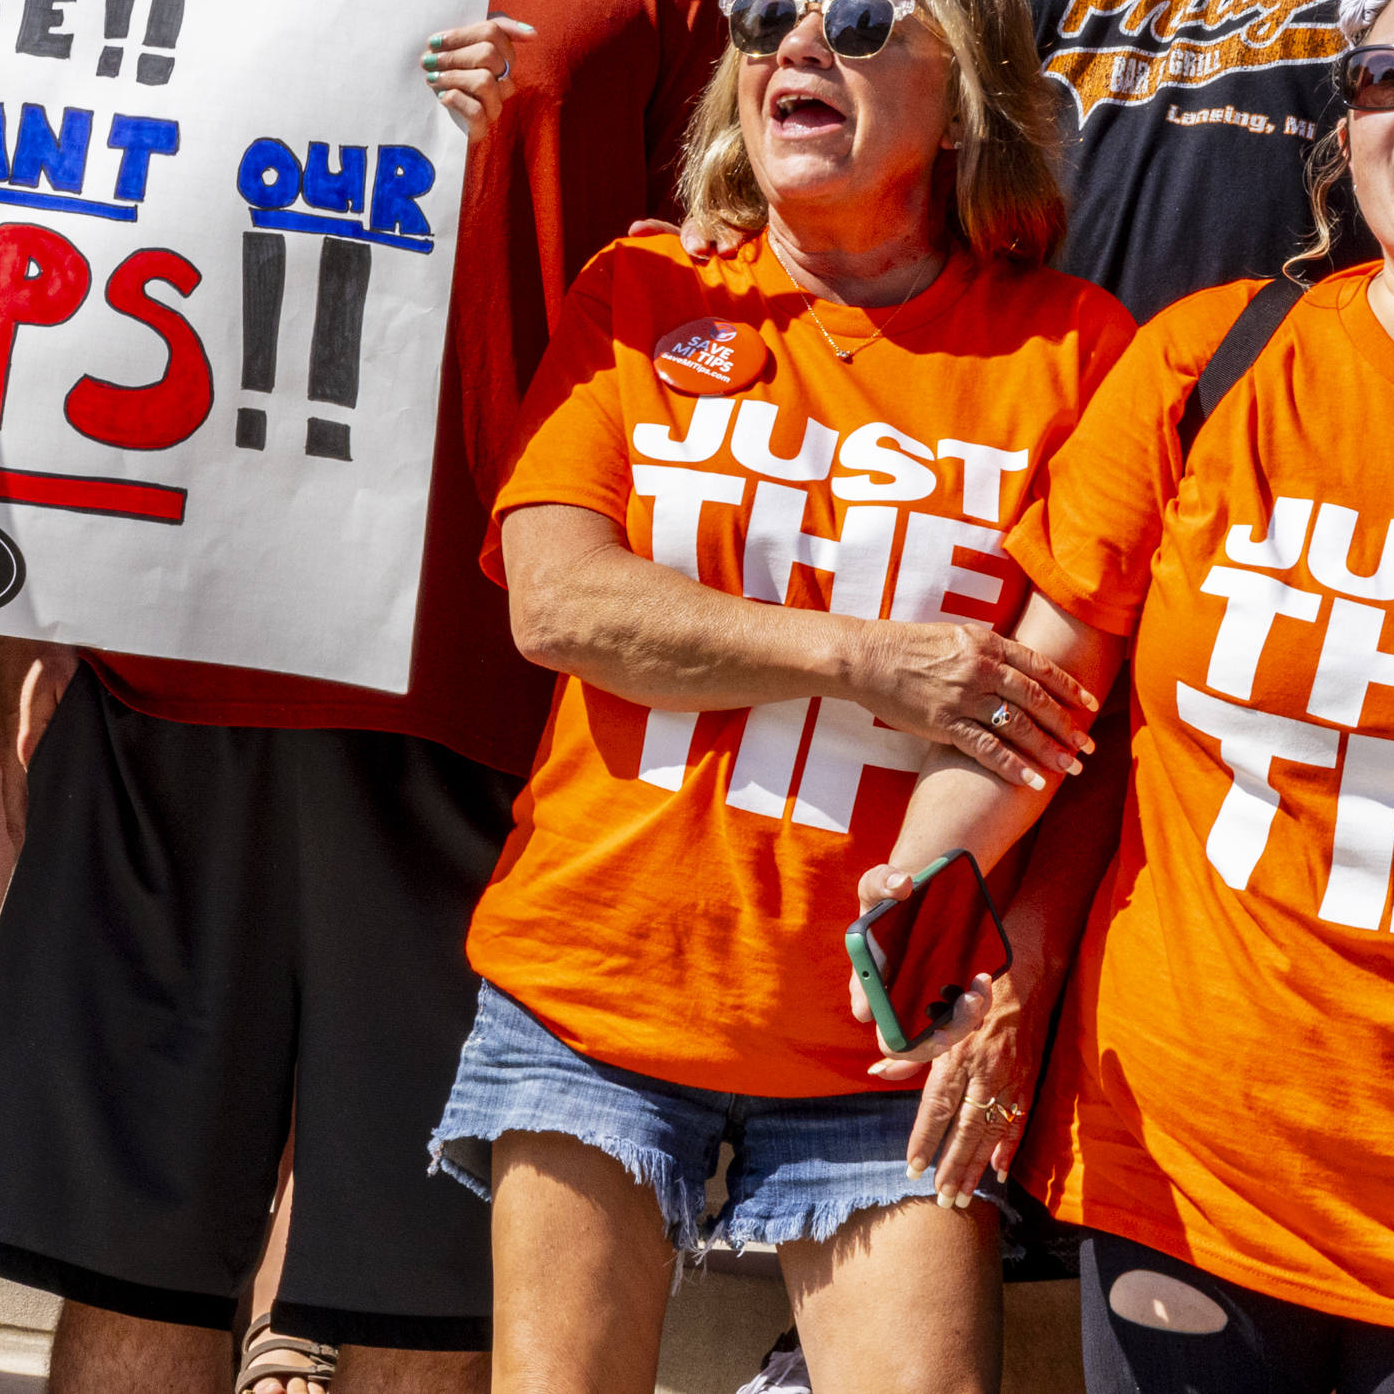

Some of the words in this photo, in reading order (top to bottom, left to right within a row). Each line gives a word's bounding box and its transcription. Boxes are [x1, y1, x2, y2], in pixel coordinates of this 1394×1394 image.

[1110, 55, 1151, 95] BAR
[236, 136, 436, 236] OUR
[672, 343, 696, 358] MI
[697, 351, 734, 373] TIPS
[688, 336, 734, 360] SAVE
[633, 395, 1029, 522] JUST
[632, 464, 1009, 634] THE
